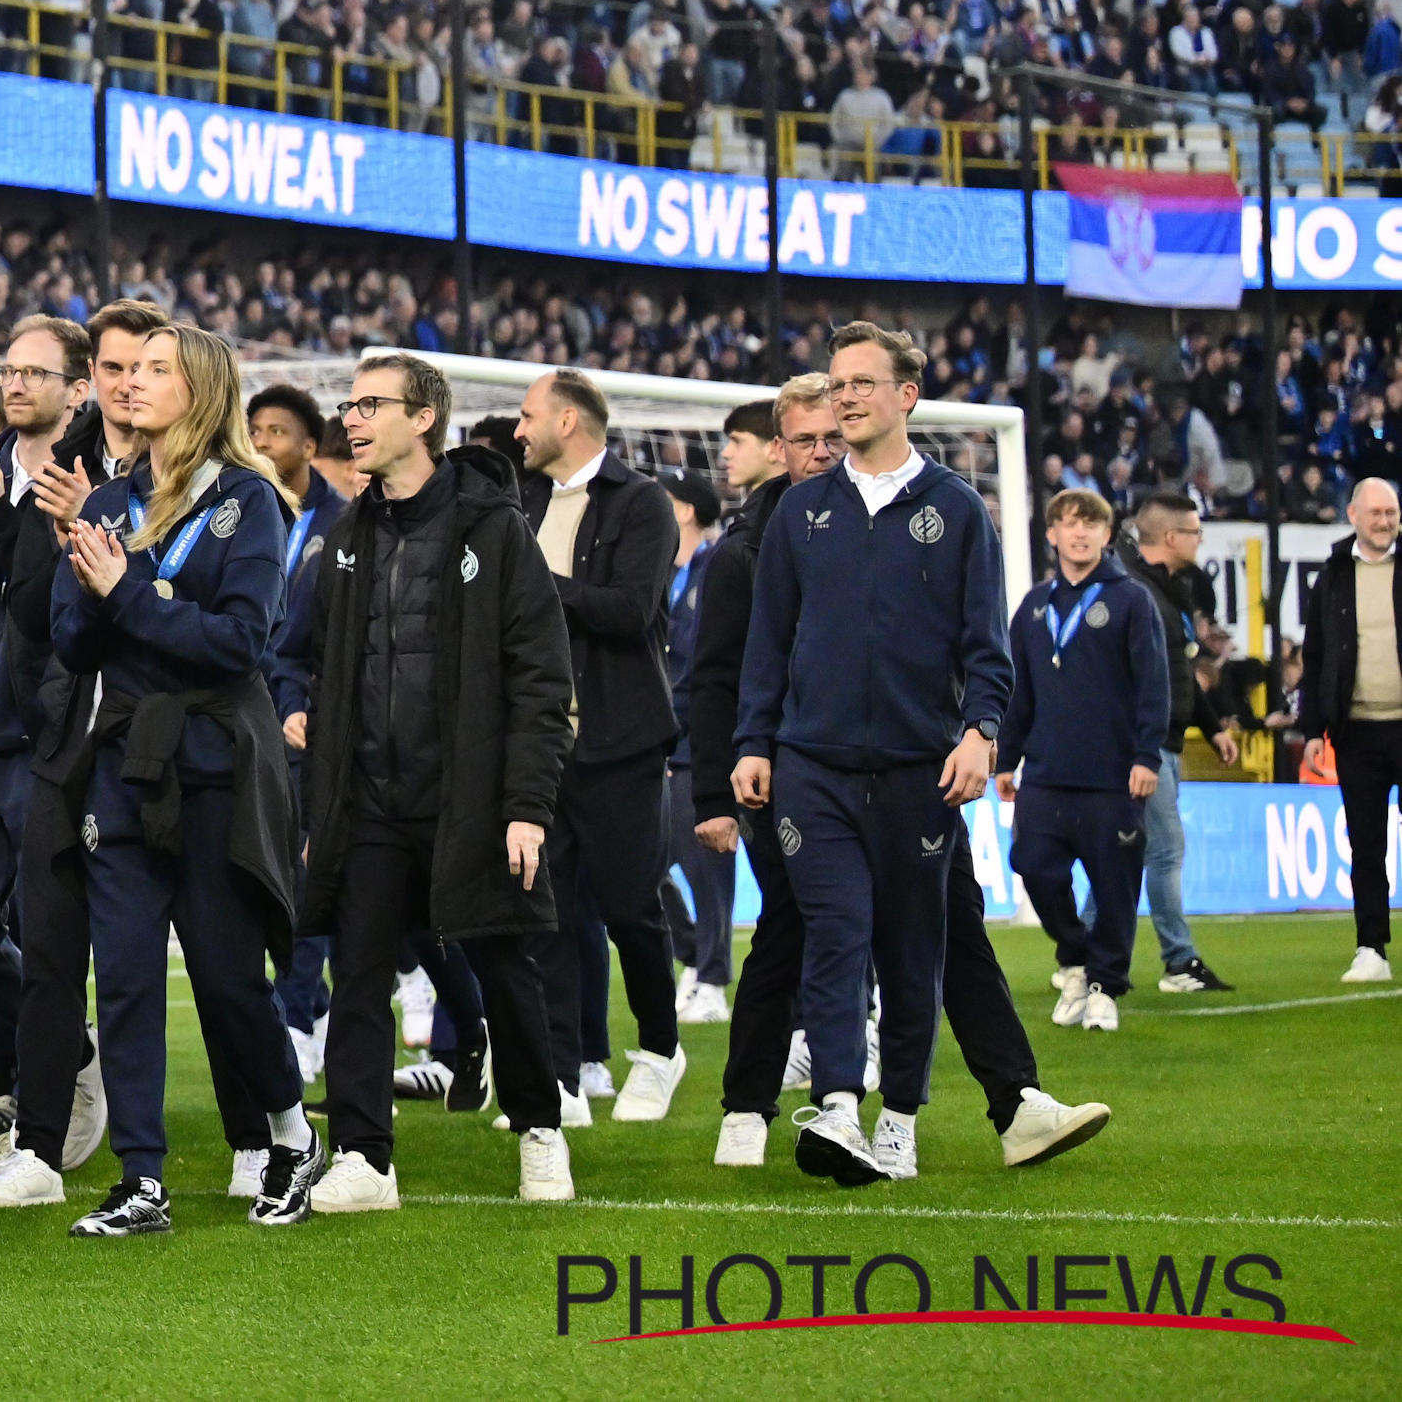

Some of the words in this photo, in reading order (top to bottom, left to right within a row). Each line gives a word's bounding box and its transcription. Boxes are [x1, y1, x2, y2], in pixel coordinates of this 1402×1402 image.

[119, 103, 193, 195] NO
[198, 113, 365, 216] SWEAT
[578, 168, 649, 252] NO
[654, 178, 867, 267] SWEAT
[1240, 205, 1358, 281] NO
[1265, 802, 1329, 900] NO
